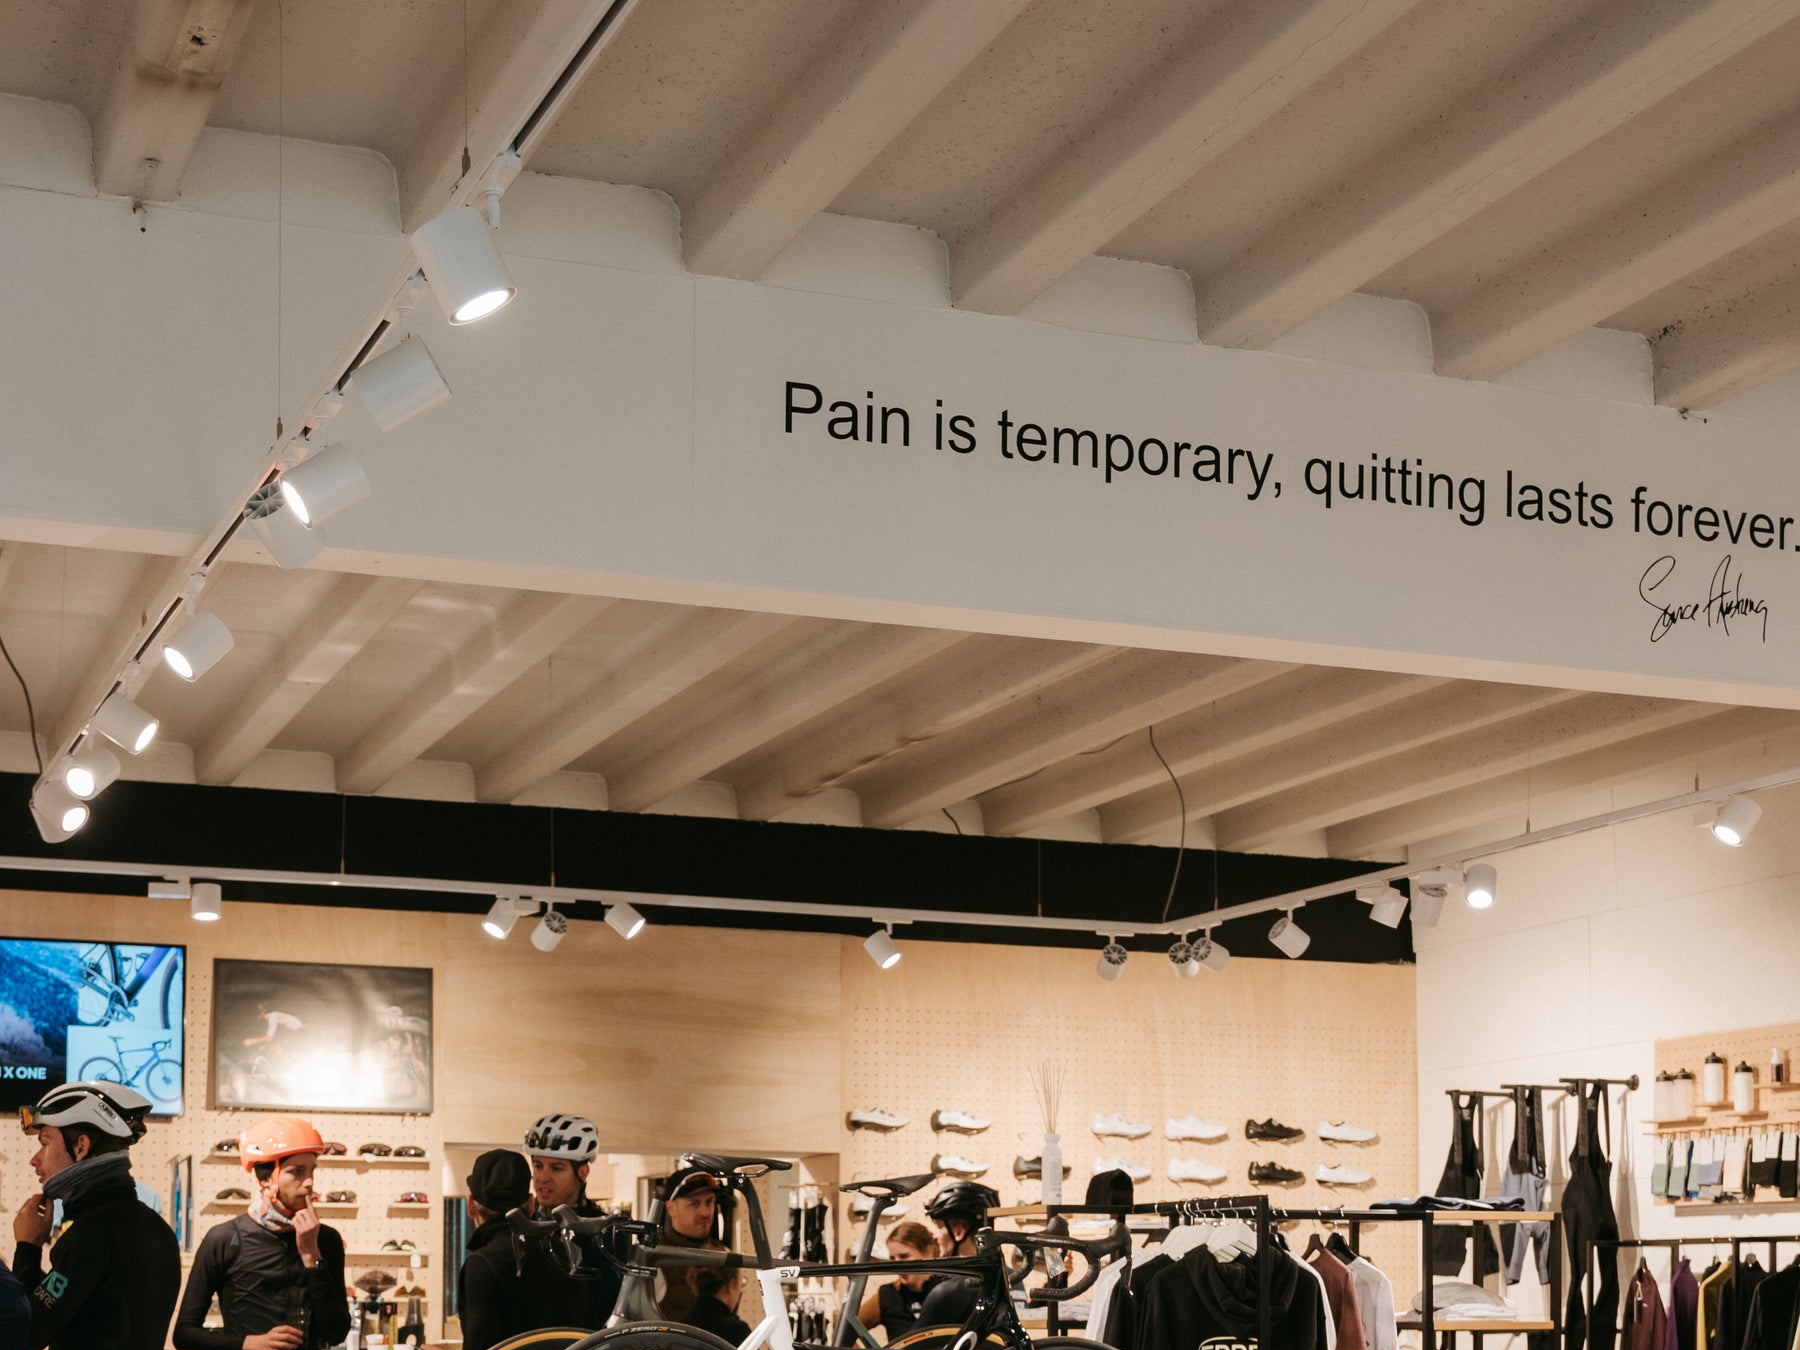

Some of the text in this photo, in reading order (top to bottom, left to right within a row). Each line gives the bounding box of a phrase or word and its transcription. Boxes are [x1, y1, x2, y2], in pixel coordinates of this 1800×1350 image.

[785, 381, 1800, 552] Pain is temporary, quitting lasts forever.
[3, 1066, 14, 1079] X
[15, 1066, 47, 1080] ONE
[780, 1269, 796, 1278] SV
